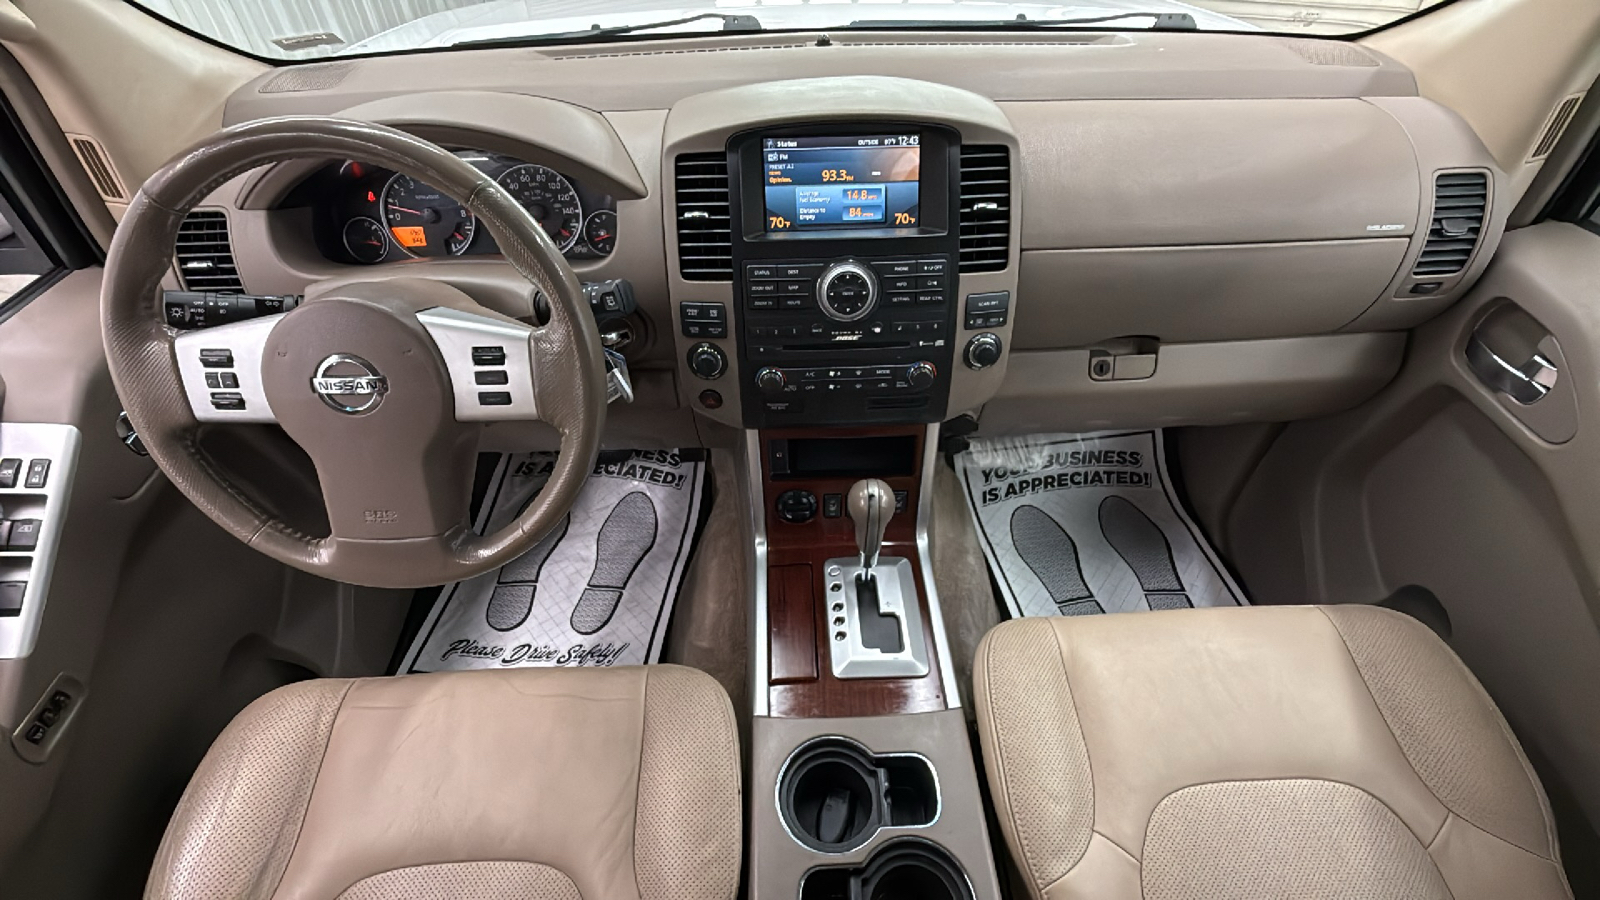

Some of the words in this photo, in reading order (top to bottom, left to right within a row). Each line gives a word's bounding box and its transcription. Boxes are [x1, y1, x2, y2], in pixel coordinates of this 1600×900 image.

[897, 135, 919, 146] 12:43
[519, 174, 531, 183] 60
[536, 174, 546, 182] 80
[508, 181, 519, 190] 40
[547, 182, 561, 190] 100
[557, 193, 571, 202] 120
[846, 189, 868, 201] 14.8
[562, 207, 575, 215] 140
[317, 380, 378, 392] NISSAN
[514, 461, 535, 475] IS
[981, 486, 1000, 505] IS
[1003, 470, 1151, 499] APPRECIATED!
[440, 638, 501, 661] Please
[501, 643, 558, 665] Drive
[556, 642, 628, 666] Safely!
